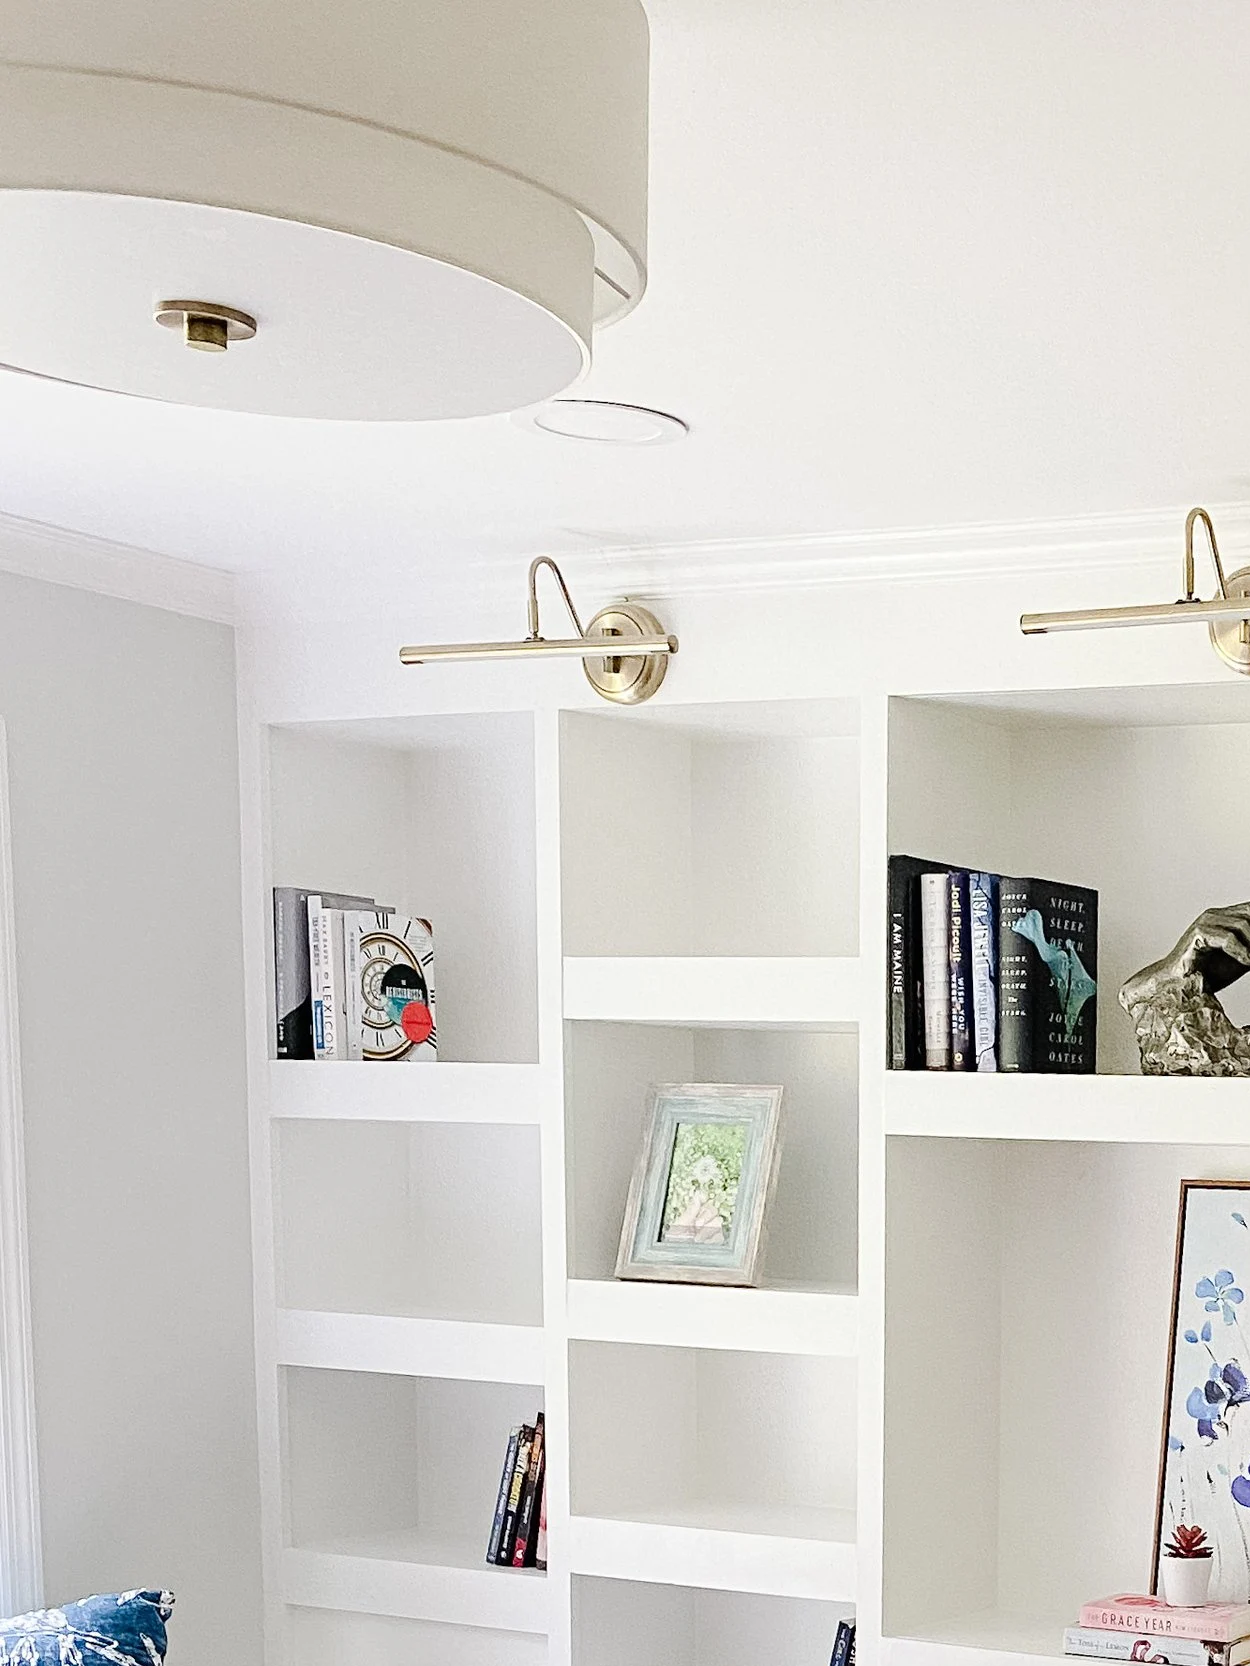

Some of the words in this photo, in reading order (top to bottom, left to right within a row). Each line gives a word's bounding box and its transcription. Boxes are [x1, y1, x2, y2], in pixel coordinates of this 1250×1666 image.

[951, 884, 961, 913] Jodi
[971, 889, 987, 917] LISA
[893, 923, 902, 945] AM
[951, 916, 962, 963] Picoult
[893, 949, 903, 994] MAINE
[322, 985, 334, 1056] LEXICON
[1048, 1051, 1084, 1065] OATES
[1101, 1612, 1140, 1628] GRACE
[1144, 1617, 1173, 1633] YEAR
